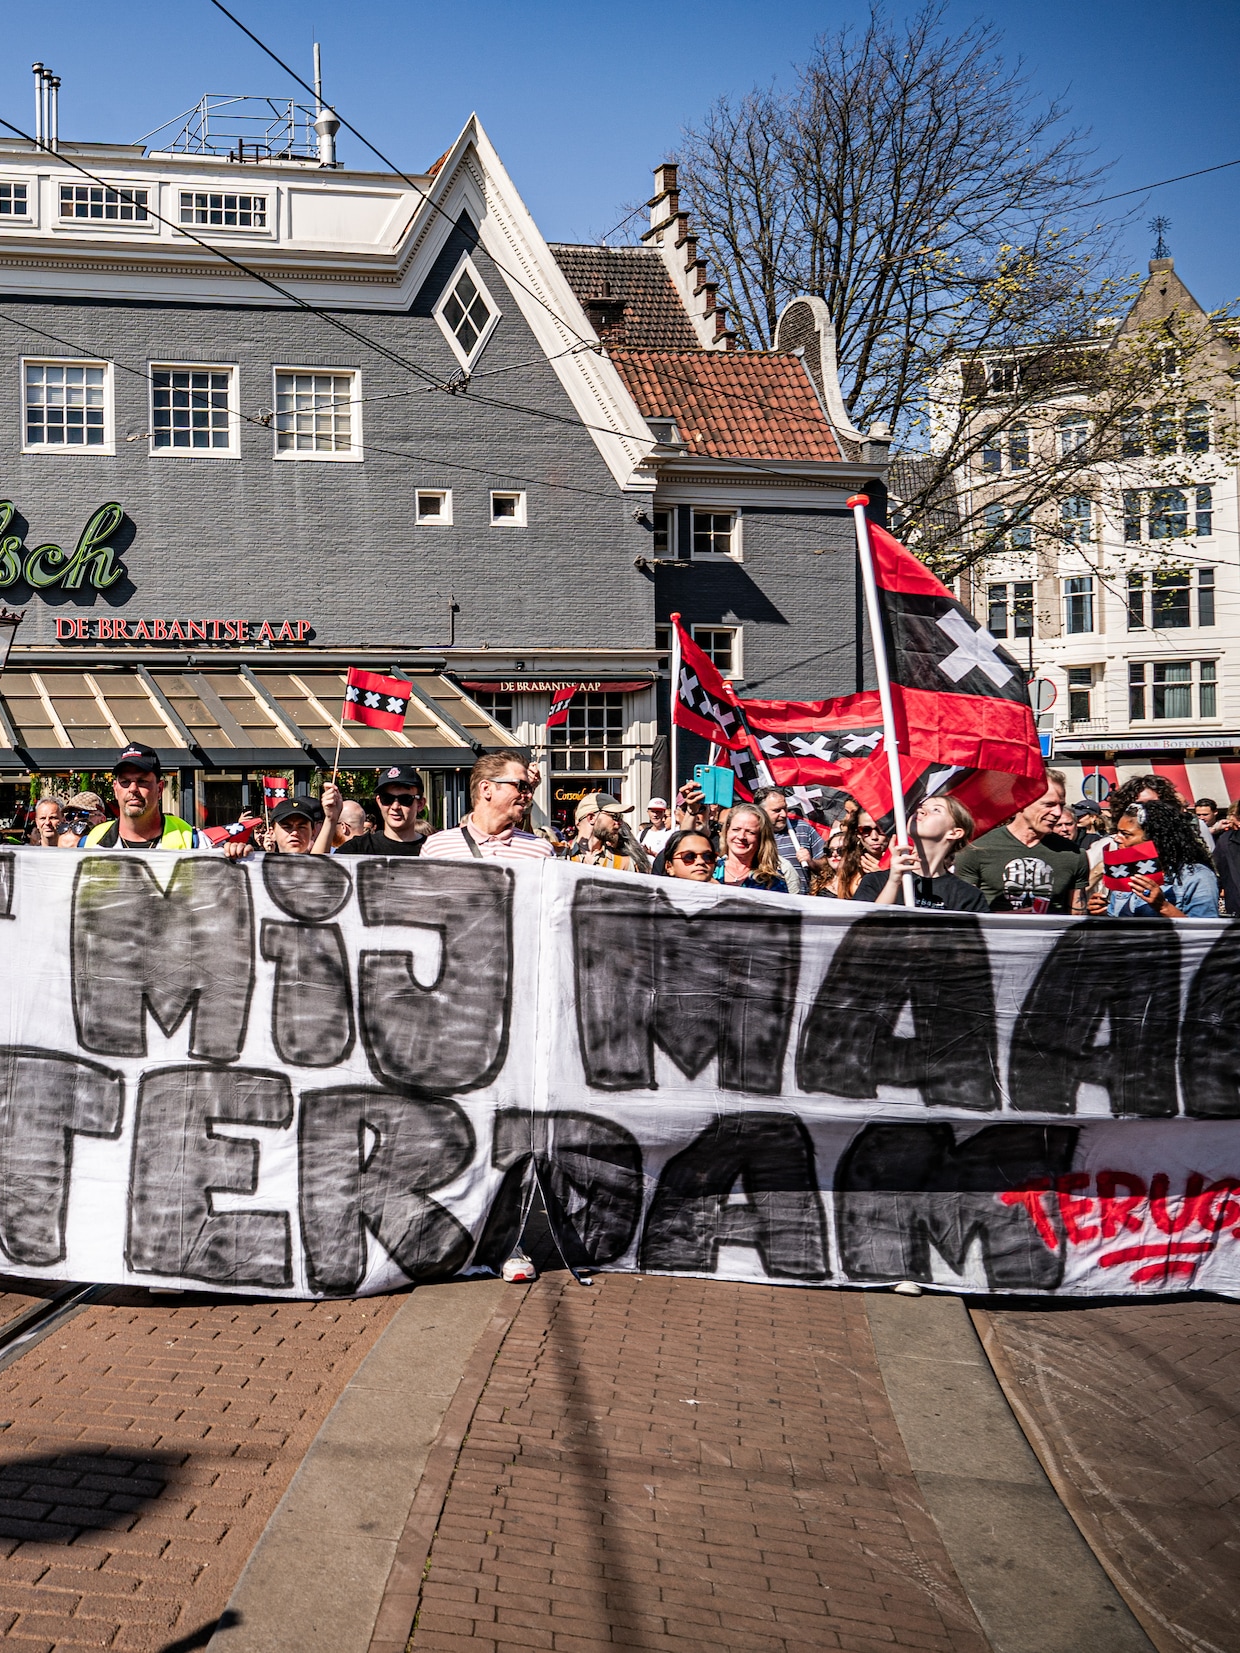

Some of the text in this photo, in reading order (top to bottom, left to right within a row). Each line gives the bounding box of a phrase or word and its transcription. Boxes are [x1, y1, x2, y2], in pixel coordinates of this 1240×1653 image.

[54, 617, 311, 641] DE BRABANTSE AAP
[500, 682, 514, 691] DE
[579, 682, 601, 691] AAP
[1079, 743, 1143, 751] ATHENAEUM
[1163, 739, 1232, 749] BOEKHANDEL
